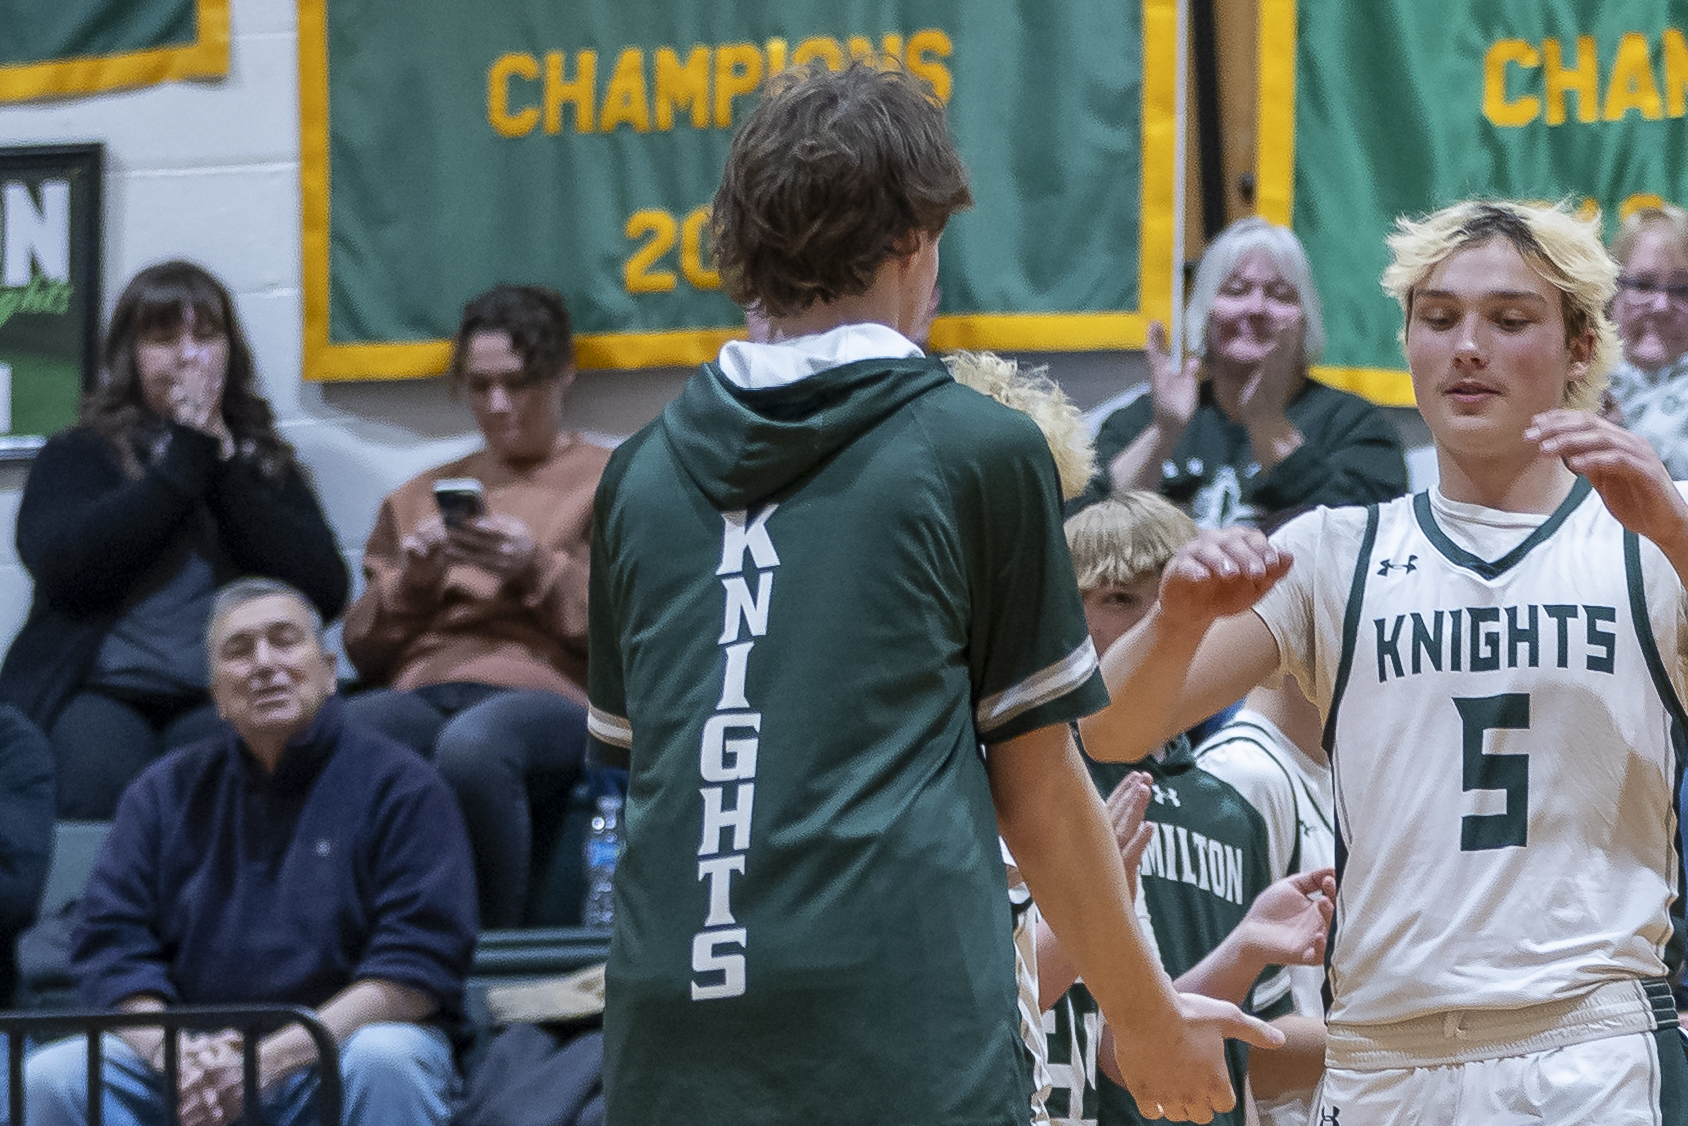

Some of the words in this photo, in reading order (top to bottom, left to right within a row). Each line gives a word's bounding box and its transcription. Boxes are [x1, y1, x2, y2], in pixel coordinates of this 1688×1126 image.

[622, 203, 724, 293] 20
[1373, 604, 1616, 684] KNIGHTS
[690, 503, 782, 1002] KNIGHTS
[1451, 692, 1530, 851] 5
